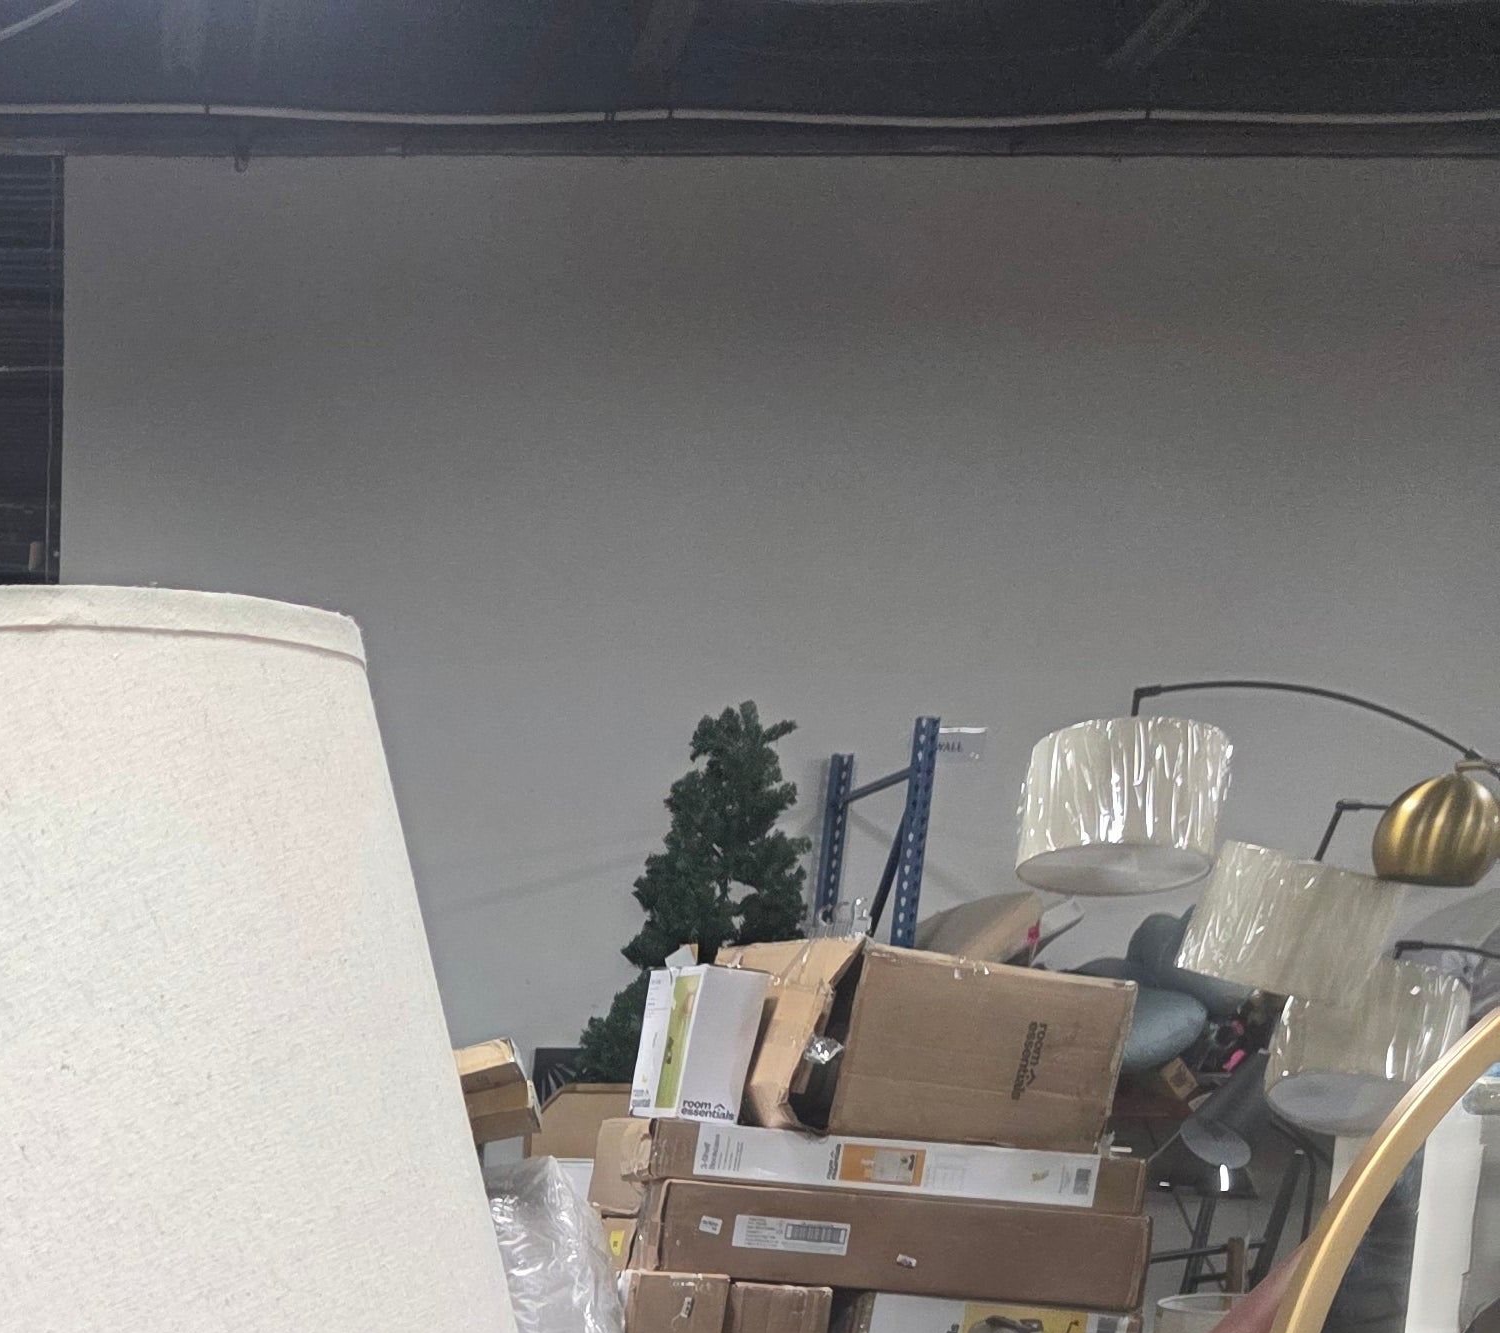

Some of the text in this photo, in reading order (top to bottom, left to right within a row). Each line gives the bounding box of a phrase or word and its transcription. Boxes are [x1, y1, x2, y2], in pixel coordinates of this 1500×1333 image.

[1030, 1023, 1047, 1066] room
[682, 1099, 712, 1110] room
[681, 1107, 734, 1121] essentials
